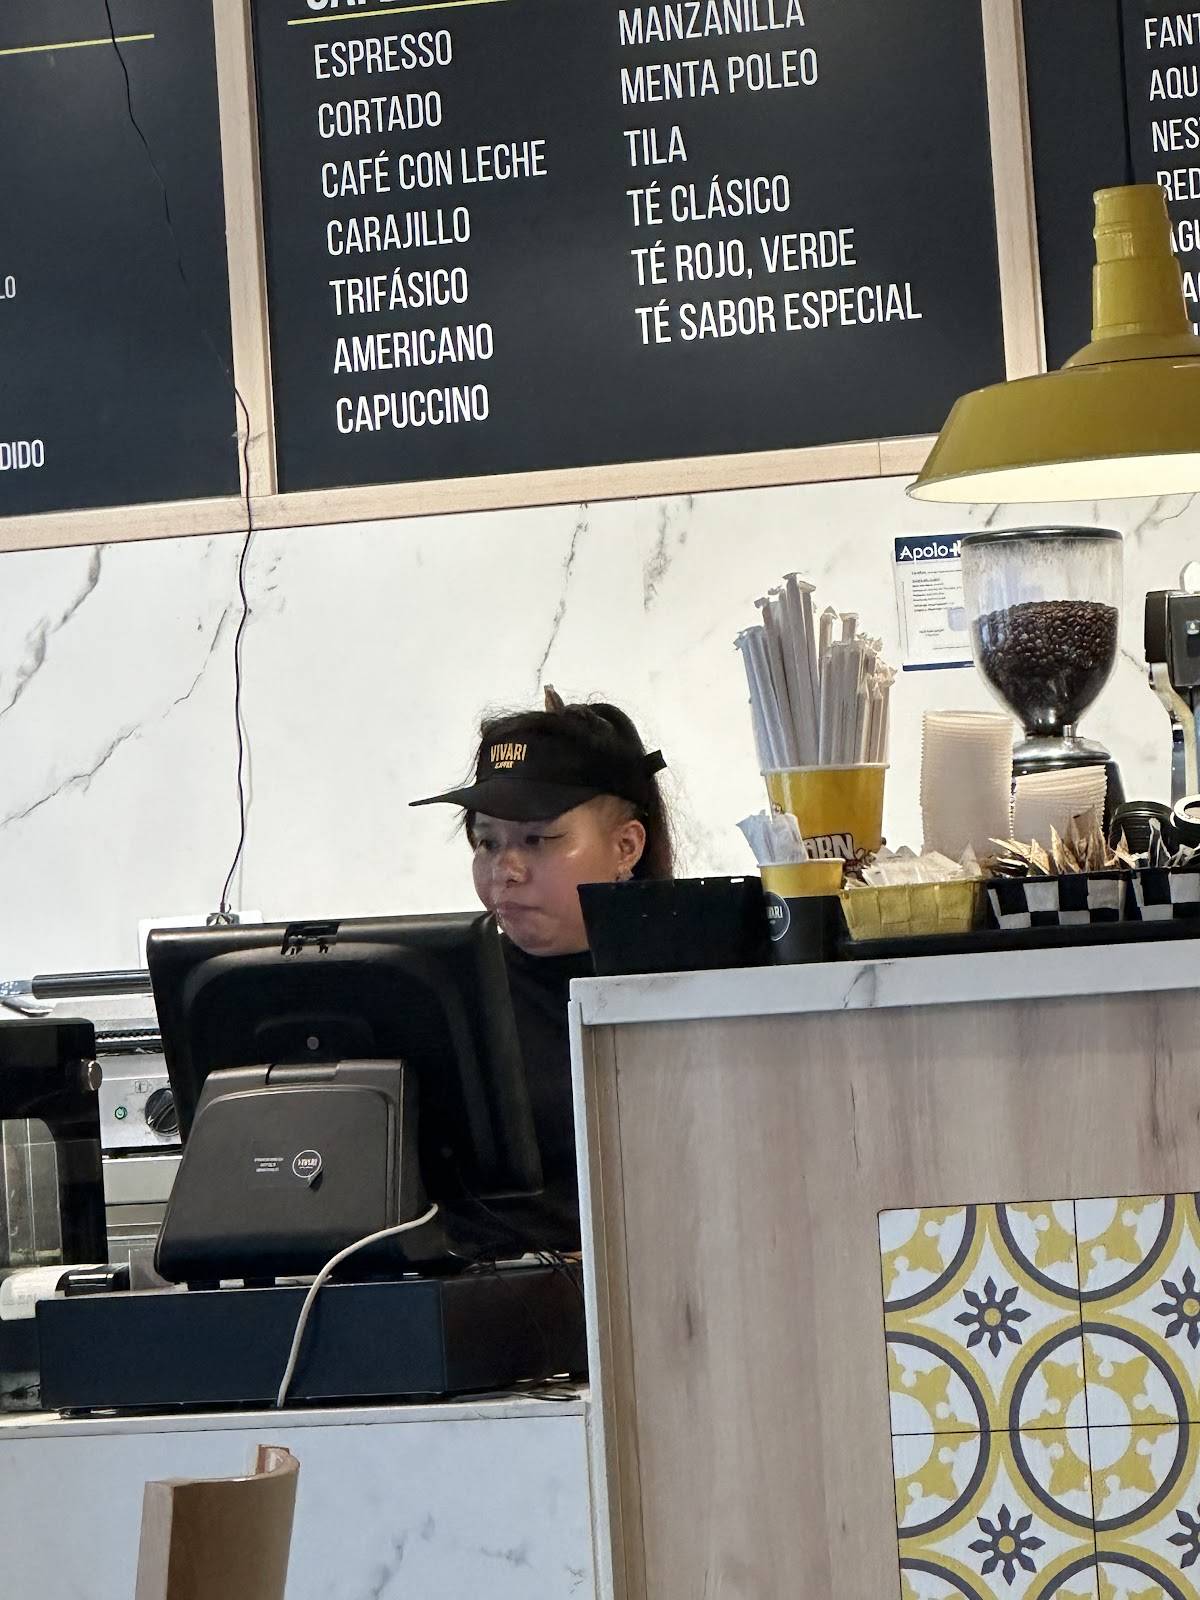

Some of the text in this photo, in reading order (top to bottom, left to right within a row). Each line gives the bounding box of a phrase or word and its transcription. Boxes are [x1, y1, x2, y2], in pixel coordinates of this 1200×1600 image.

[618, 0, 805, 45] MANZANILLA
[314, 30, 452, 79] ESPRESSO
[620, 48, 818, 104] MENTA POLEO
[1150, 66, 1198, 101] AQU
[318, 91, 442, 138] CORTADO
[1152, 116, 1200, 152] NES
[322, 140, 547, 198] CAFÉ CON LECHE
[624, 126, 687, 166] TILA
[627, 175, 790, 226] TÉ CLÁSICO
[326, 207, 470, 256] CARAJILLO
[631, 228, 856, 285] TÉ ROJO, VERDE
[329, 267, 468, 315] TRIFÁSICO
[635, 283, 922, 344] TÉ SABOR ESPECIAL
[333, 323, 493, 374] AMERICANO
[336, 384, 489, 433] CAPUCCINO
[490, 743, 527, 762] VIVARI
